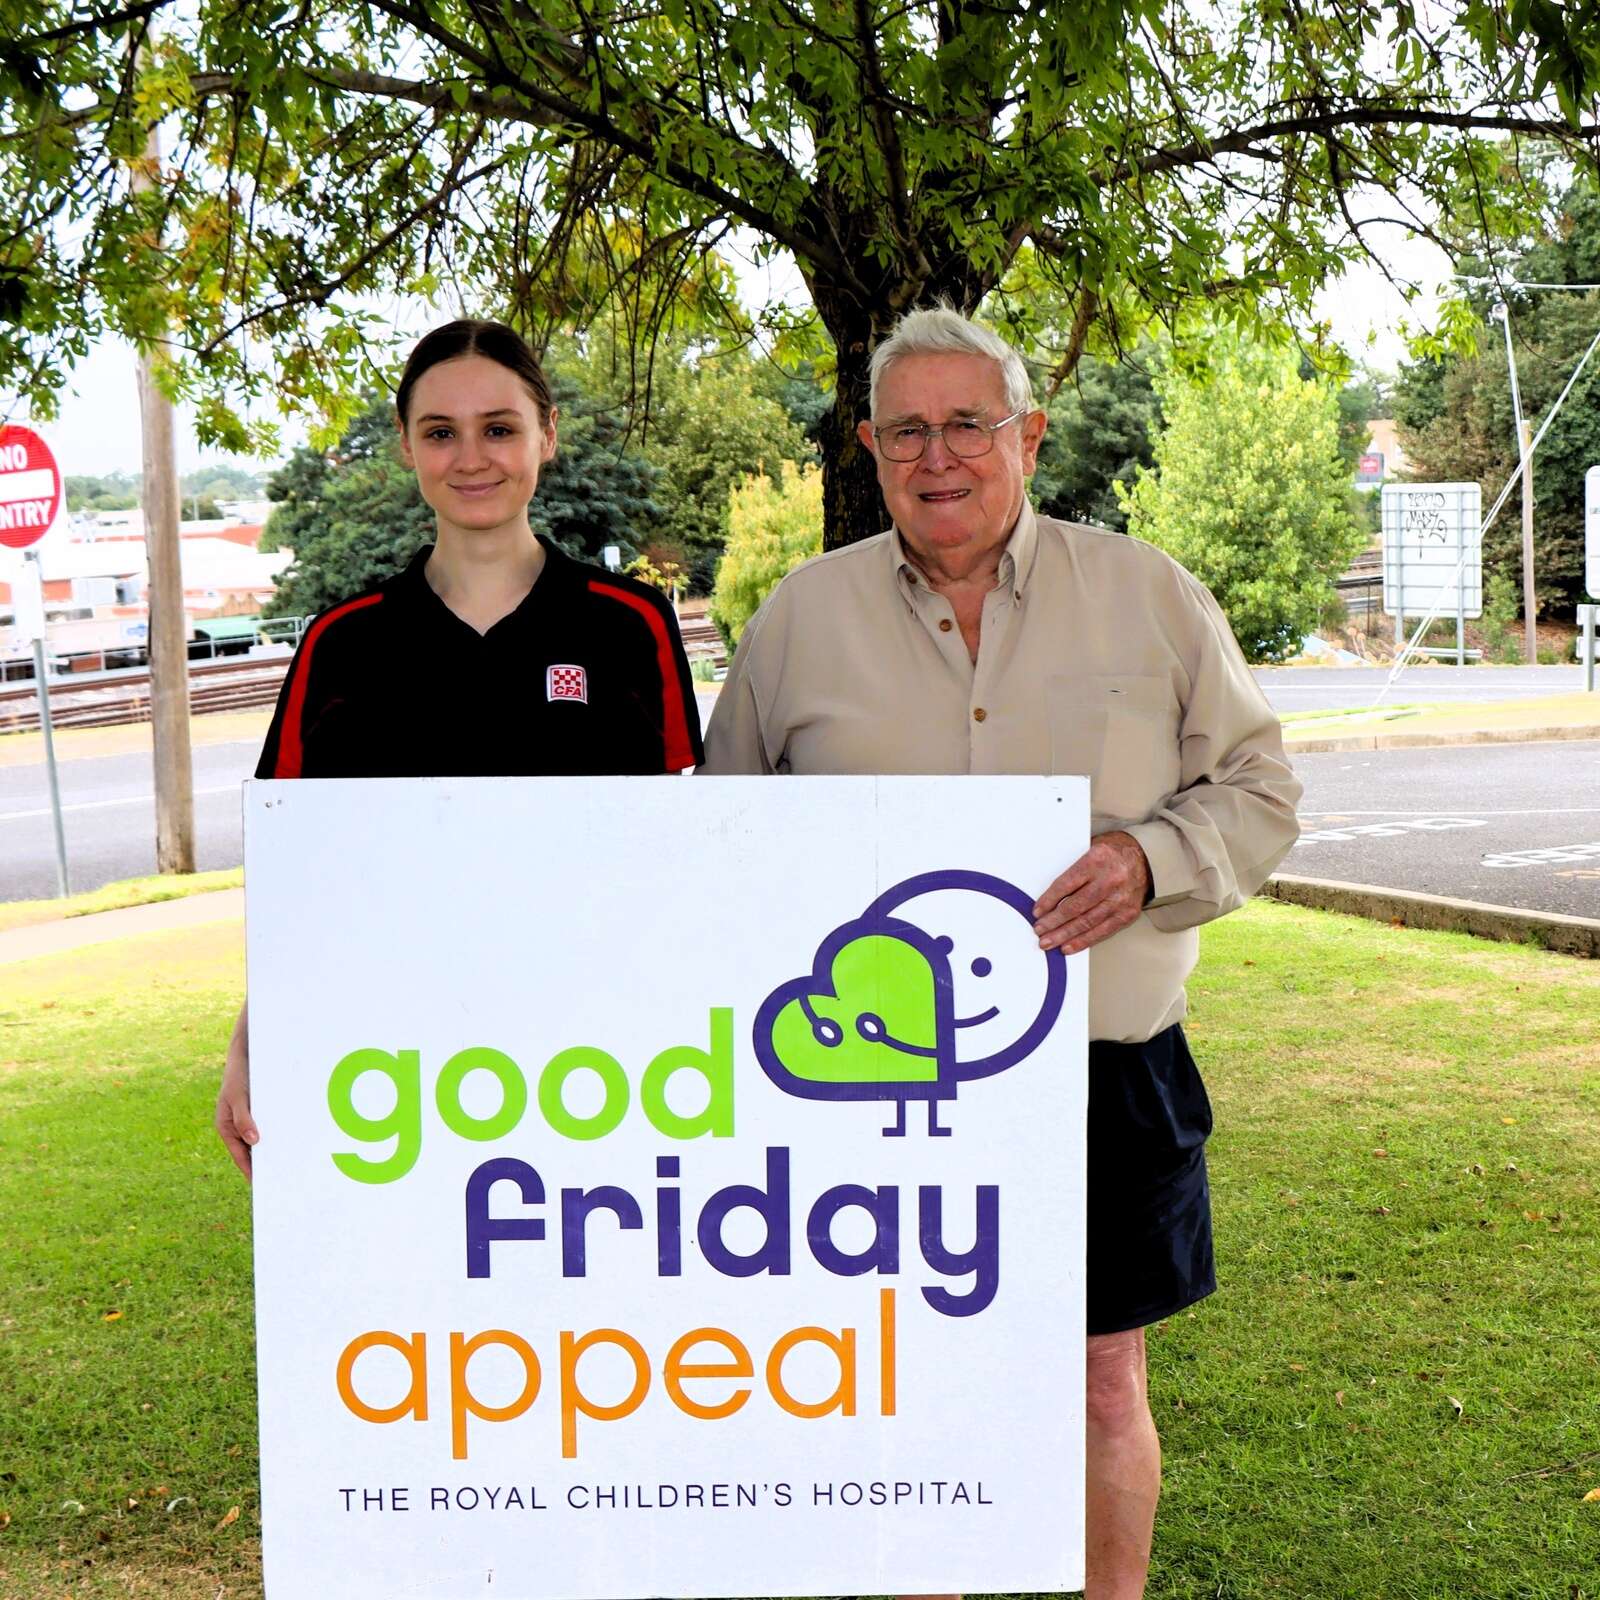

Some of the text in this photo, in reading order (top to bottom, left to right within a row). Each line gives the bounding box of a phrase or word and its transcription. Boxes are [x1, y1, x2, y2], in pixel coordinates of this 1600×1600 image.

[0, 444, 28, 471] NO
[0, 499, 52, 530] NTRY
[554, 686, 582, 696] CFA
[1480, 842, 1600, 868] EEP
[327, 1007, 735, 1185] good
[465, 1146, 1000, 1318] friday
[336, 1287, 897, 1461] appeal
[338, 1481, 994, 1512] THE ROYAL CHILDREN'S HOSPITAL
